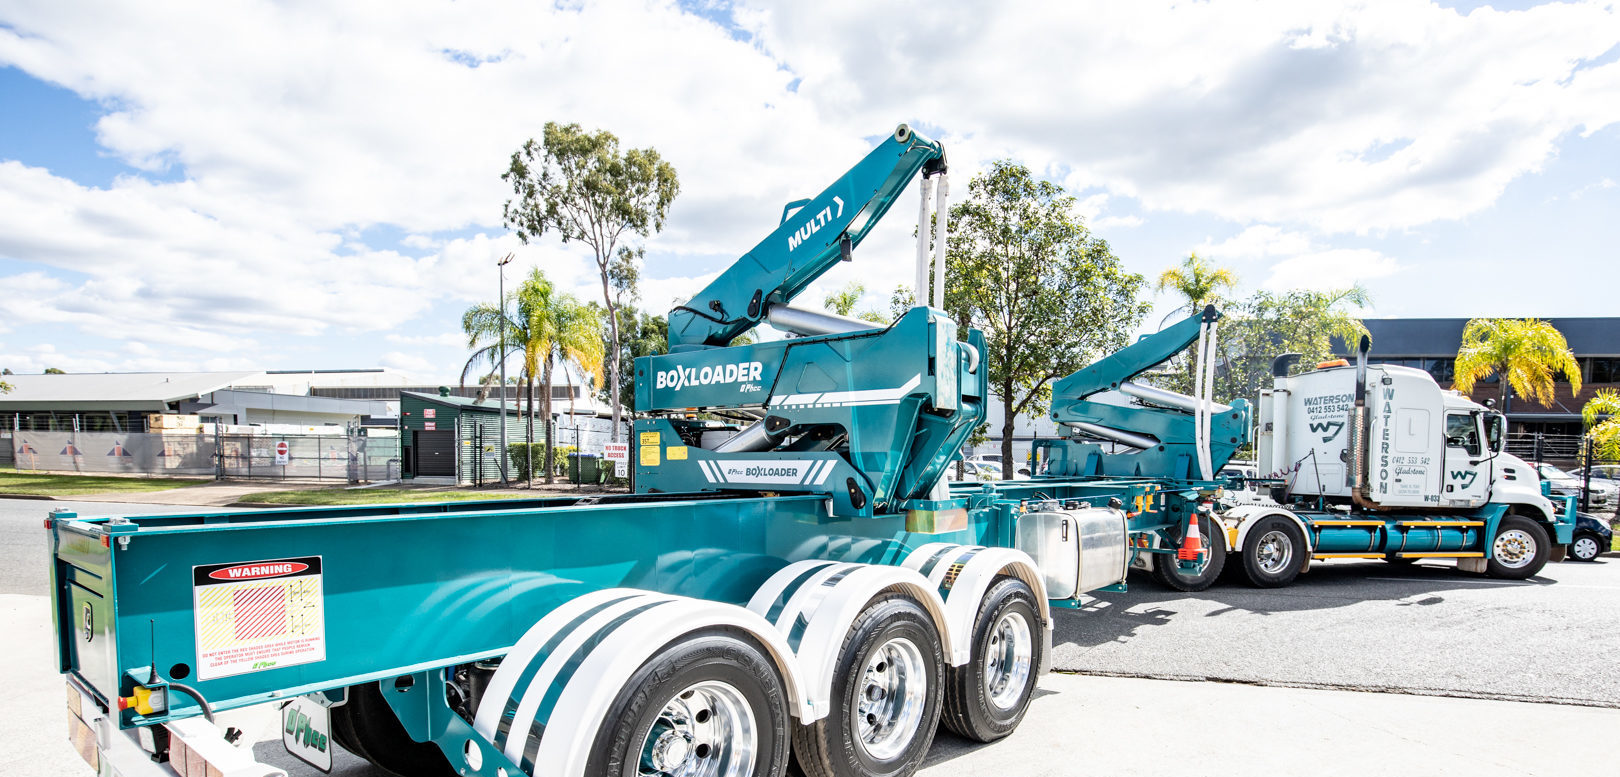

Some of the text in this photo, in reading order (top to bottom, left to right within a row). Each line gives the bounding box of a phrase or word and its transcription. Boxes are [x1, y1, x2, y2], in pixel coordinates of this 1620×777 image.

[788, 206, 832, 252] MULTI
[656, 361, 762, 391] BOXLOADER
[1304, 394, 1354, 406] WATERSON
[1307, 404, 1349, 414] 0412 553 542
[605, 443, 626, 451] NO TRUCK
[1380, 388, 1394, 494] WATERSON
[1392, 456, 1430, 465] 0412 553 542
[745, 466, 798, 478] BOXLOADER
[1395, 467, 1426, 476] Gladstone
[228, 564, 292, 578] WARNING
[286, 705, 327, 753] O'Phee
